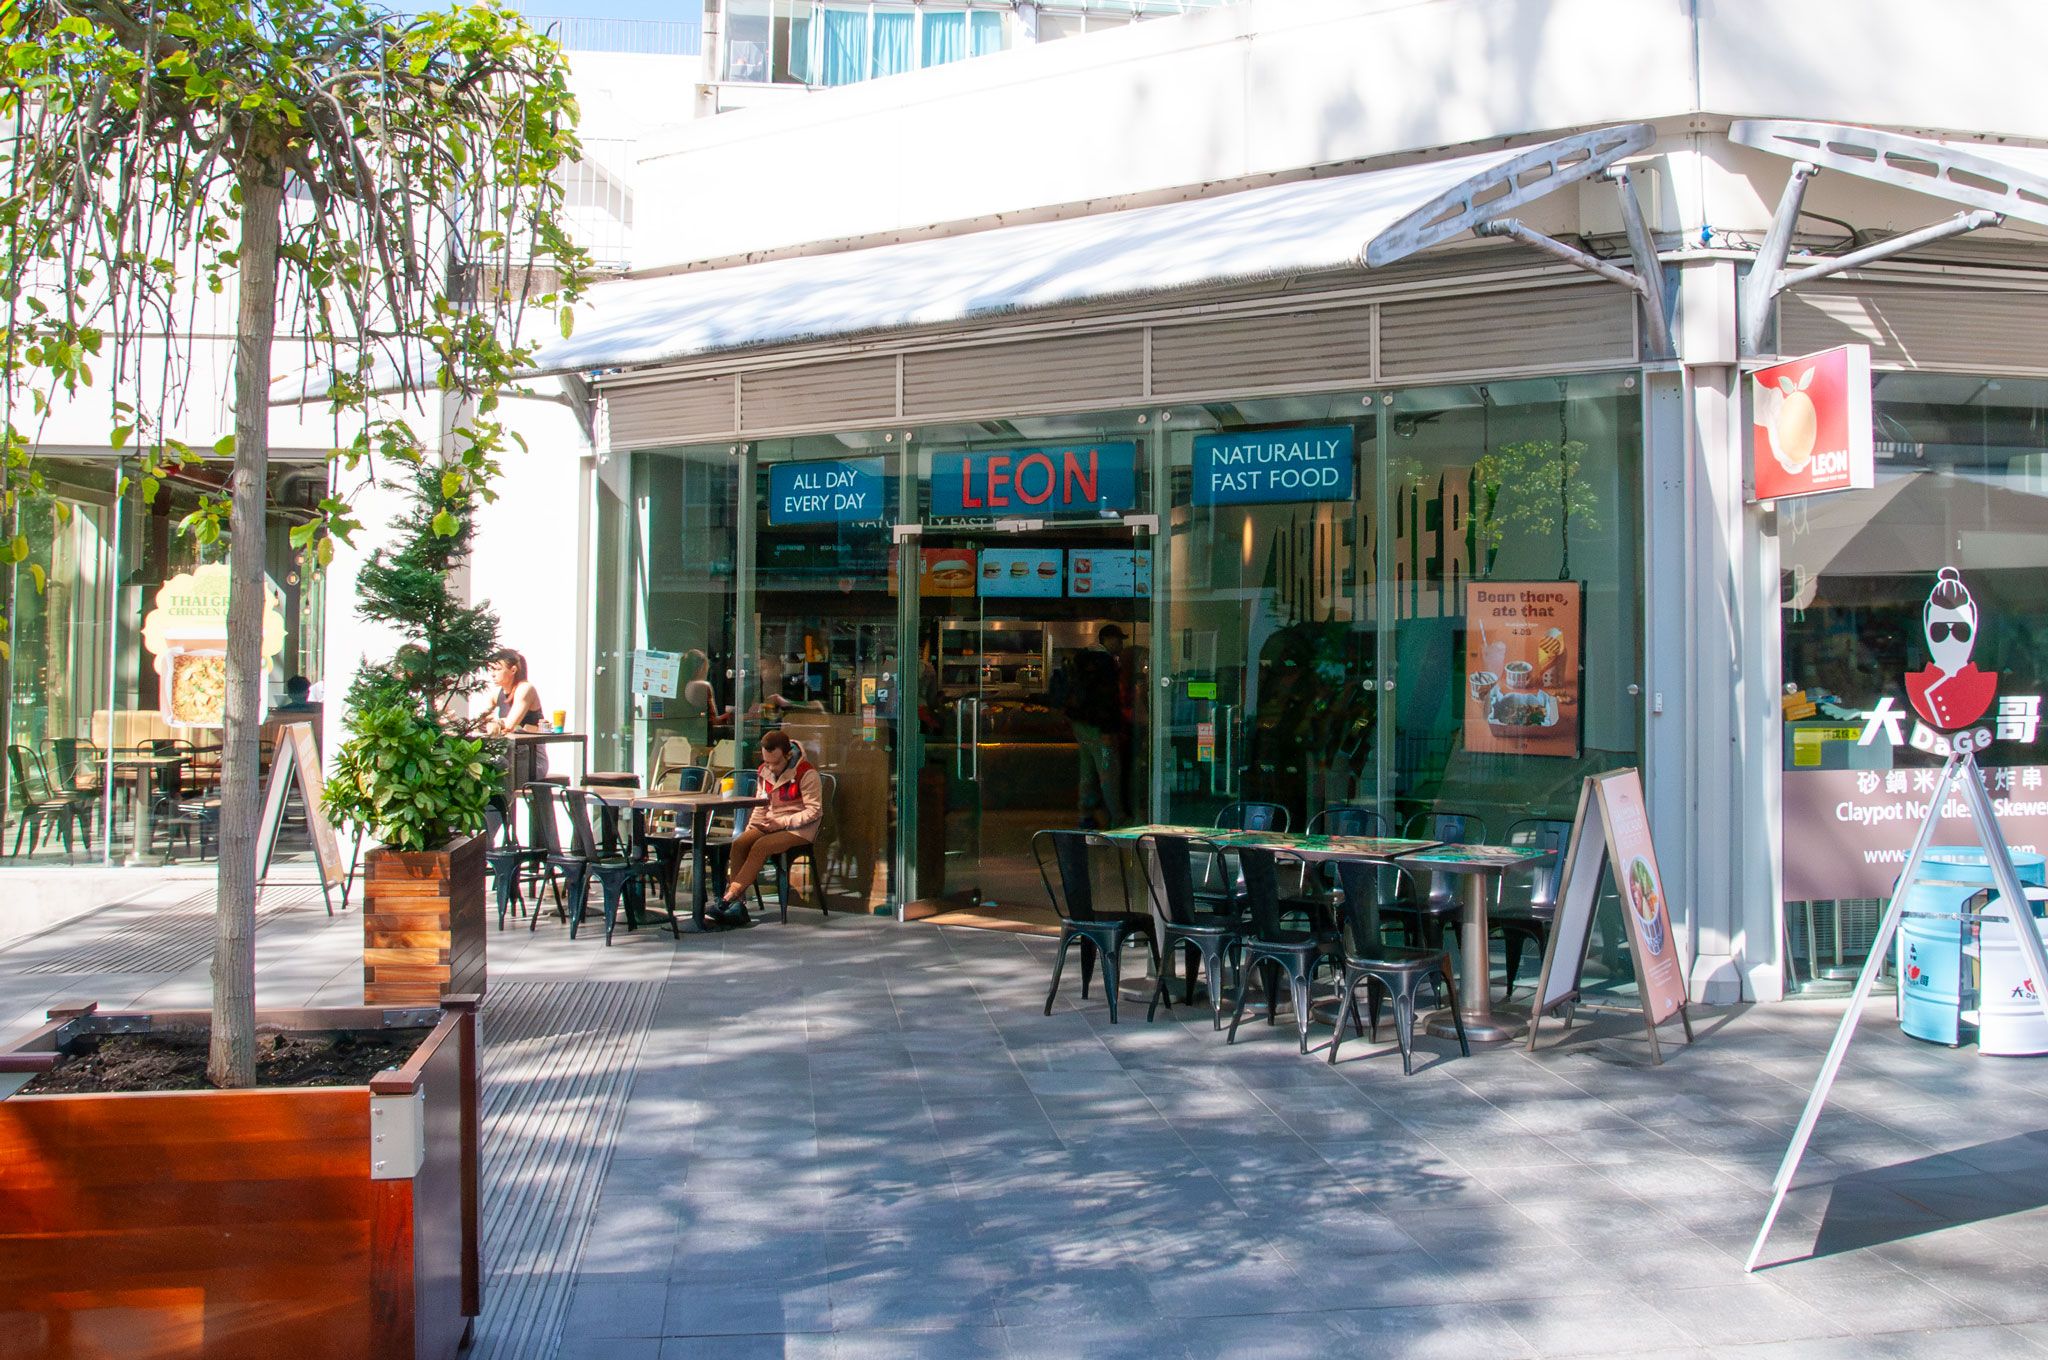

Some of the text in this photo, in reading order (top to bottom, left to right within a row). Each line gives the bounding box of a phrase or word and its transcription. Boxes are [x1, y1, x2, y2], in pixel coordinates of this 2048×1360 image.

[1211, 440, 1340, 466] NATURALLY
[1811, 450, 1848, 476] LEON
[793, 470, 858, 490] ALL DAY
[962, 450, 1099, 508] LEON
[1211, 467, 1339, 492] FAST FOOD
[784, 493, 867, 513] EVERY DAY
[170, 595, 206, 607] THAI
[1477, 590, 1569, 606] Bean there,
[1492, 604, 1554, 617] ate that
[168, 607, 220, 616] CHICKEN
[1857, 697, 1907, 746] 大
[1996, 695, 2042, 743] 哥
[1836, 798, 2048, 826] Claypot Nodles Skewe
